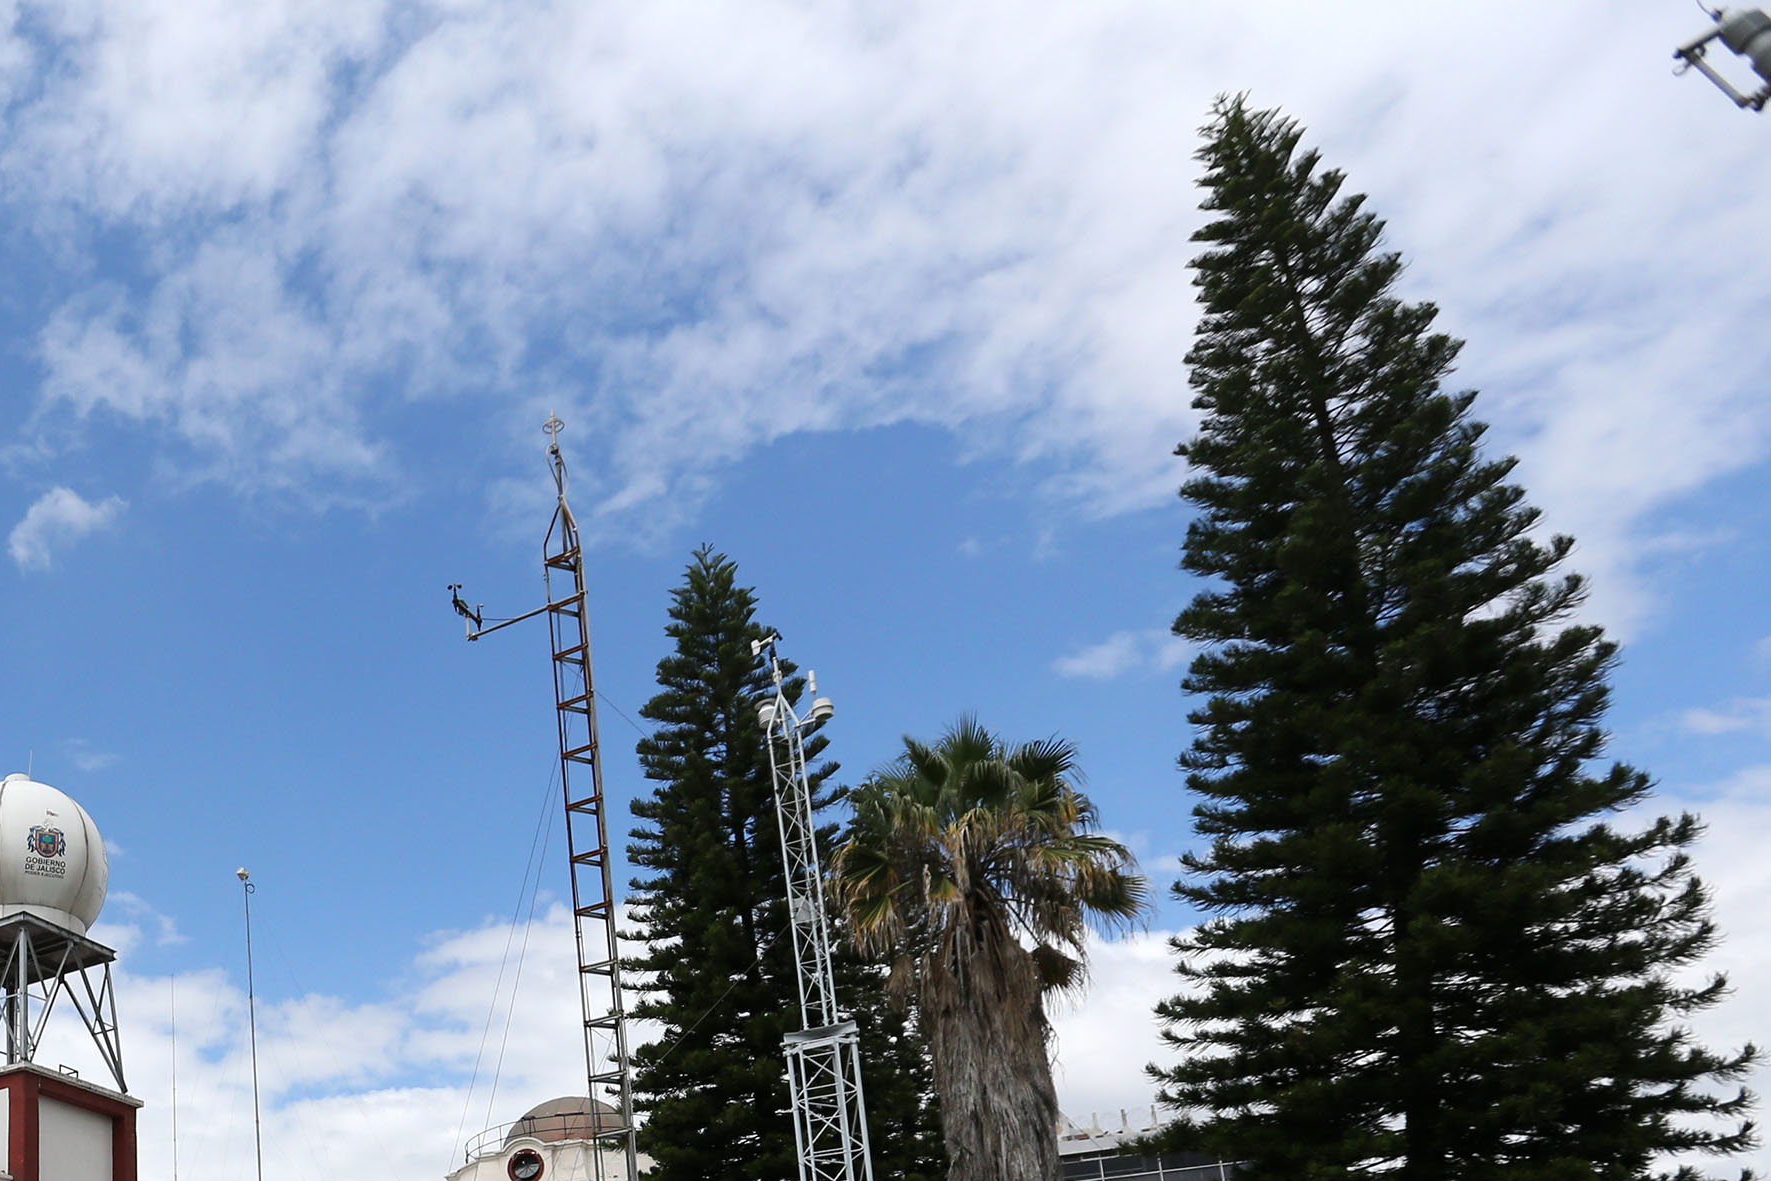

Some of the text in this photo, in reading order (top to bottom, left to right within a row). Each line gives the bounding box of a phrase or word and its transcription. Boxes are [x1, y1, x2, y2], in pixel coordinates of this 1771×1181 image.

[25, 856, 66, 868] GOBIERNO
[24, 863, 66, 875] DE JALISCO
